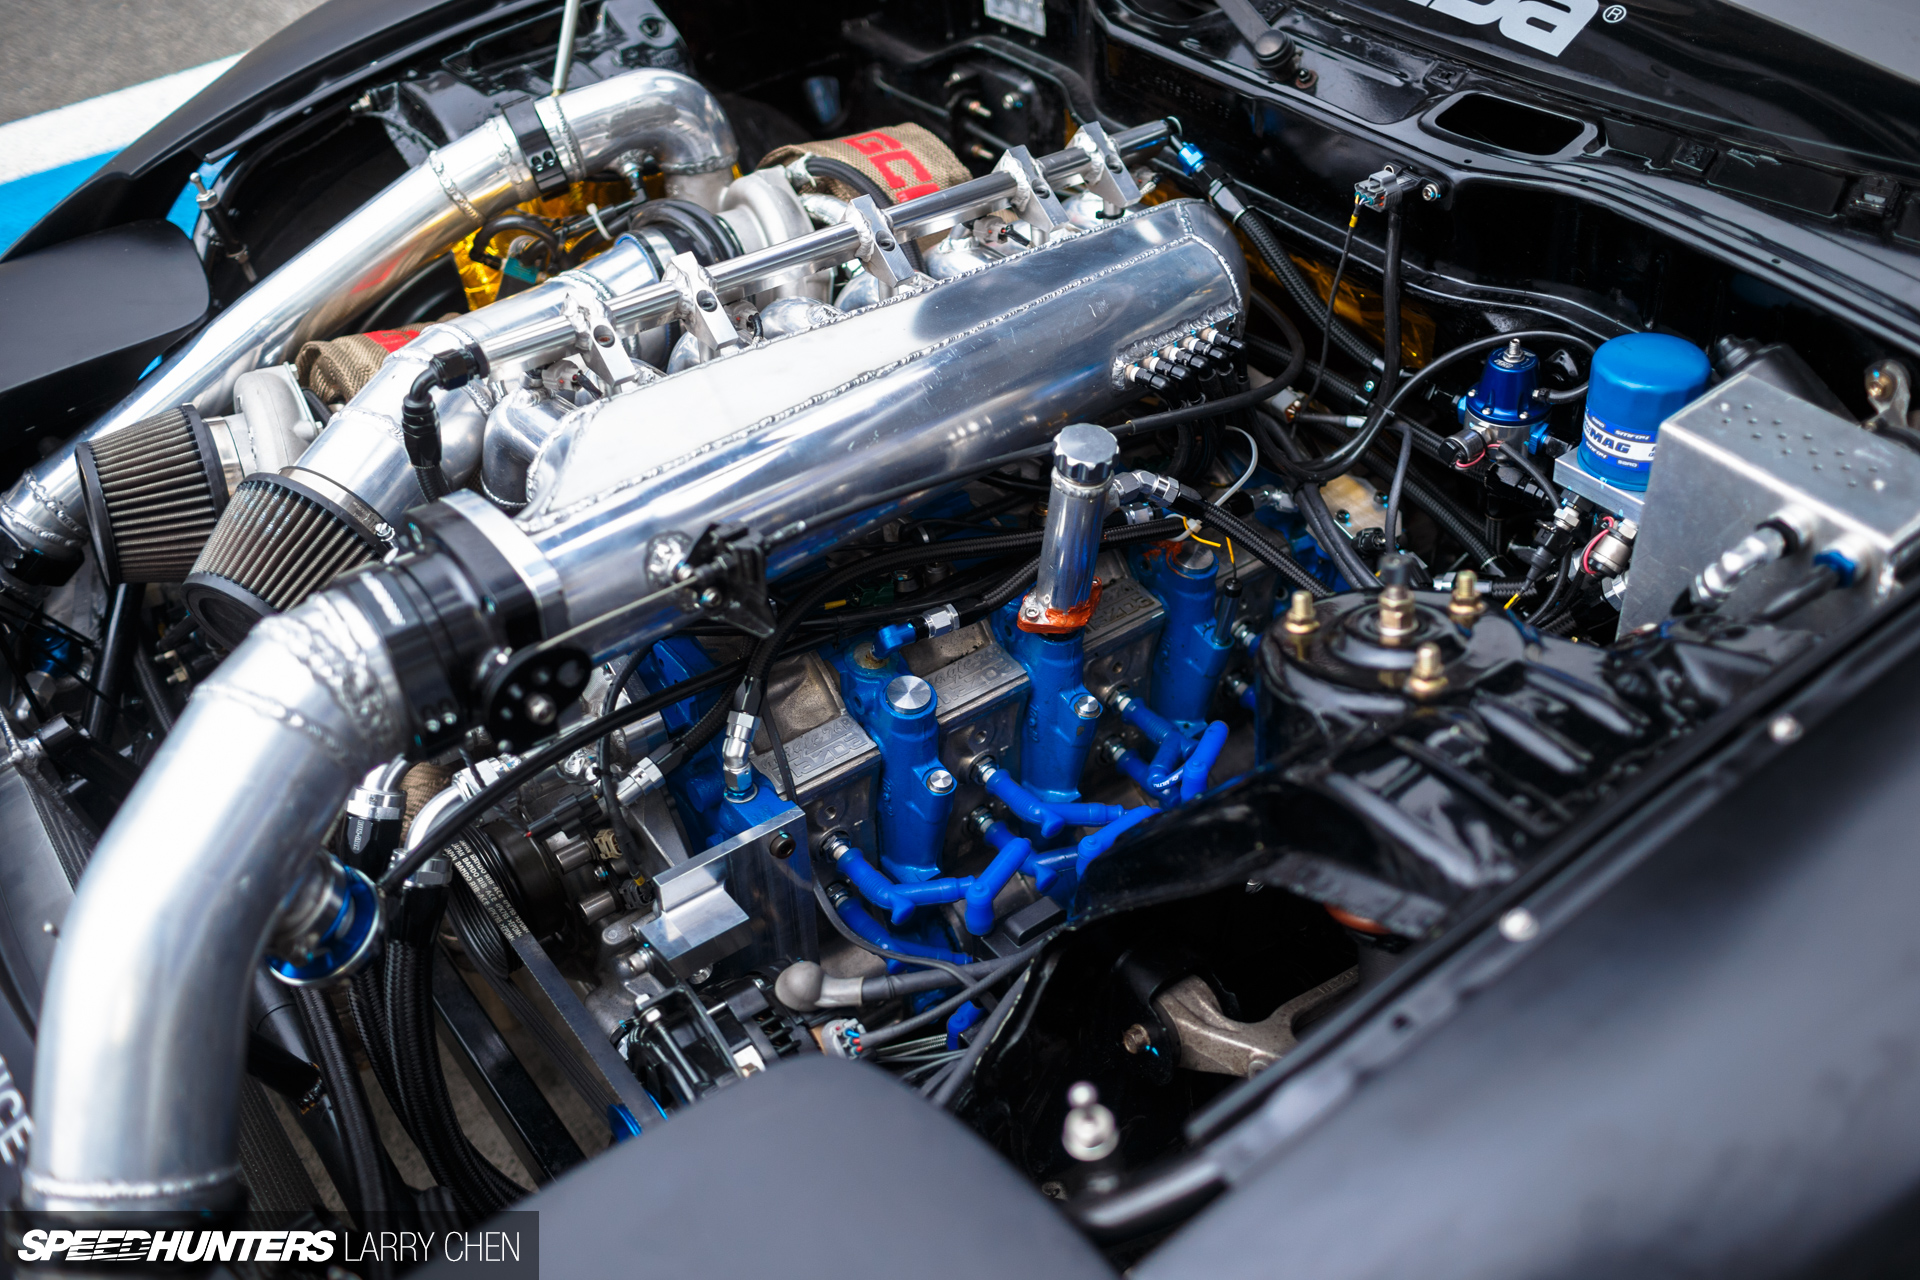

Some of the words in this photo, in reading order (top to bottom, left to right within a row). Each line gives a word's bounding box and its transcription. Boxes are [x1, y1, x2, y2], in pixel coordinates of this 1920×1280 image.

[455, 861, 472, 881] BANDO
[469, 881, 490, 906] RIB-ACE
[462, 857, 479, 877] BANDO
[477, 877, 497, 902] RIB-ACE
[470, 854, 487, 874] BANDO
